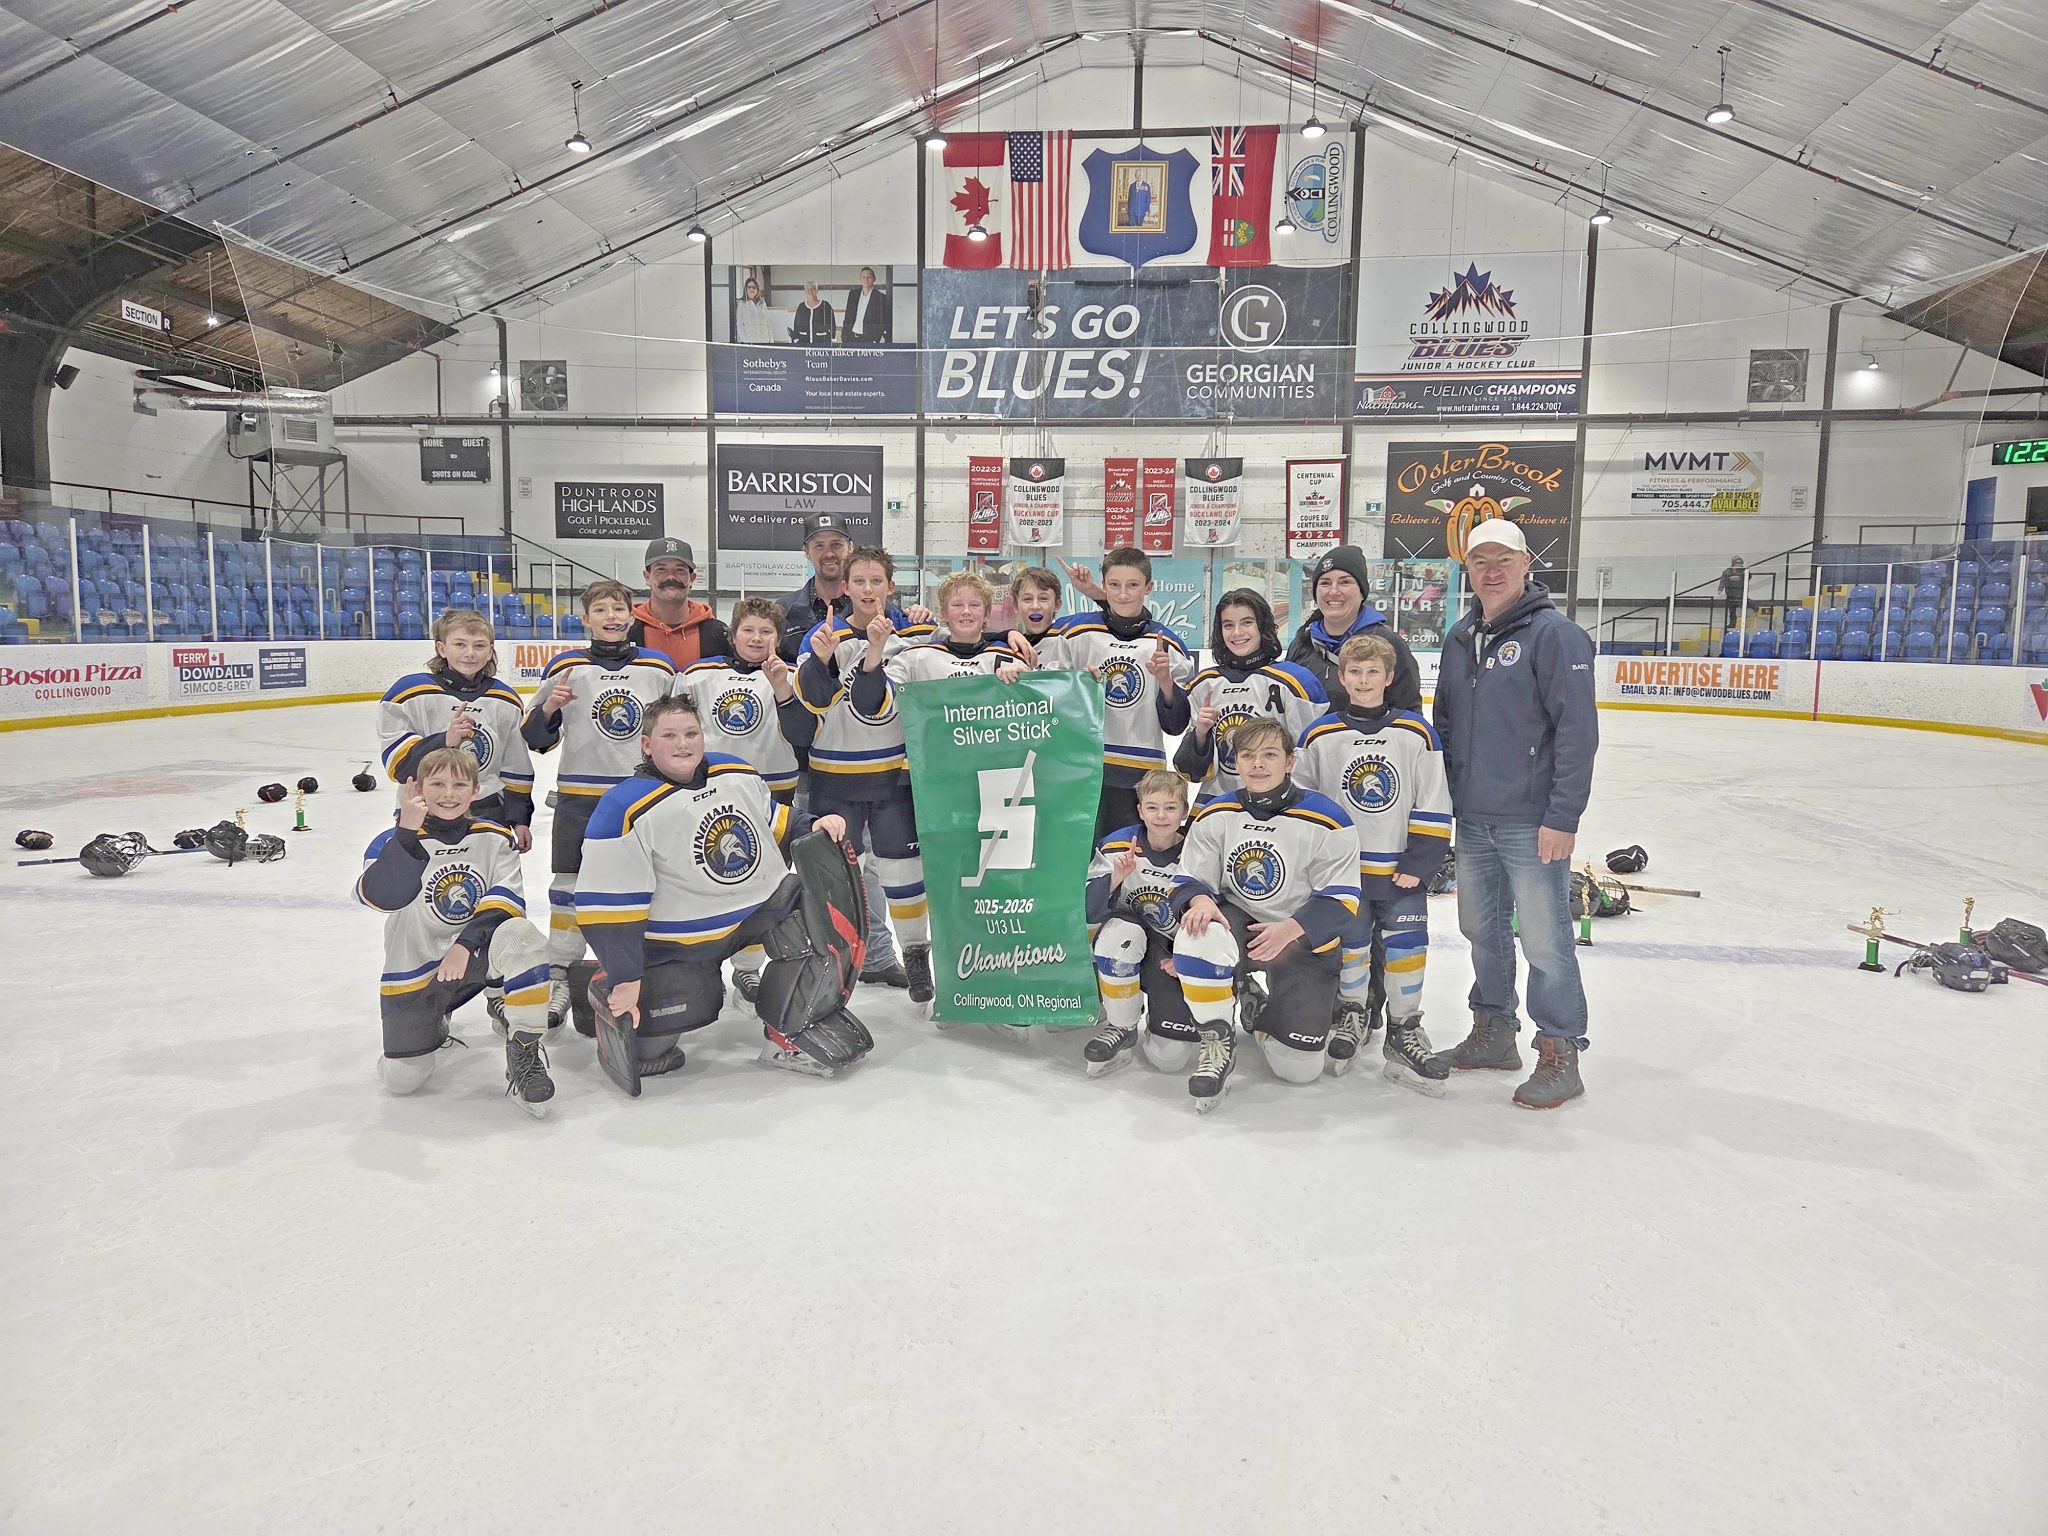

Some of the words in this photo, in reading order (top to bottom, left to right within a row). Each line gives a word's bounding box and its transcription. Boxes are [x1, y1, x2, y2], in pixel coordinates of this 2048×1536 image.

[1327, 147, 1341, 237] COLLINGWOOD
[125, 306, 158, 326] SECTION
[164, 318, 171, 330] R
[949, 305, 1060, 341] LET'S
[1071, 304, 1141, 341] GO
[1230, 294, 1270, 342] G
[1410, 321, 1529, 335] COLLINGWOOD
[805, 349, 830, 357] Rioux
[857, 349, 885, 357] Davies
[1408, 334, 1531, 360] BLUES
[743, 358, 787, 369] Sotheby's
[804, 360, 828, 369] Team
[1401, 362, 1441, 370] JUNIOR
[1446, 361, 1452, 369] A
[1457, 361, 1502, 369] HOCKEY
[1507, 360, 1536, 368] CLUB
[937, 349, 1150, 400] BLUES!
[1186, 363, 1315, 384] GEORGIAN
[749, 383, 782, 392] Canada
[805, 390, 818, 398] Your
[863, 391, 886, 399] experts.
[1186, 385, 1315, 399] COMMUNITIES
[1423, 385, 1484, 397] FUELING
[1486, 383, 1577, 396] CHAMPIONS
[1356, 400, 1419, 415] Nutrafarms
[1436, 402, 1500, 412] www.nutrafarms.ca
[1511, 402, 1562, 411] 1.844.224.7007
[423, 439, 444, 447] HOME
[462, 439, 485, 447] GUEST
[1397, 449, 1476, 493] Osler
[1475, 443, 1563, 492] Brook
[1645, 452, 1730, 471] MVMT
[728, 469, 872, 495] BARRISTON
[1013, 485, 1060, 493] COLLINGWOOD
[1189, 485, 1238, 493] COLLINGWOOD
[1430, 478, 1452, 495] Golf
[1453, 473, 1471, 484] and
[1472, 470, 1508, 483] Country
[1510, 477, 1531, 493] Club
[561, 486, 657, 498] DUNTROON
[562, 499, 657, 513] HIGHLANDS
[784, 498, 817, 509] LAW
[1711, 499, 1759, 509] AVAILABLE
[567, 516, 592, 525] GOLF
[600, 516, 652, 526] PICKLEBALL
[729, 515, 746, 523] We
[750, 514, 787, 524] deliver
[1390, 513, 1429, 525] Believe
[1511, 513, 1557, 525] Achieve
[1151, 580, 1196, 592] Home
[1109, 642, 1139, 650] CCM
[176, 651, 208, 664] TERRY
[0, 665, 80, 687] Boston
[85, 662, 142, 682] Pizza
[182, 665, 248, 681] DOWDALL
[521, 669, 542, 678] EMAIL
[1615, 660, 1723, 687] ADVERTISE
[1728, 663, 1780, 690] HERE
[35, 685, 112, 700] COLLINGWOOD
[183, 680, 252, 695] SIMCOE-GREY
[1621, 684, 1645, 694] EMAIL
[1647, 685, 1658, 695] US
[1659, 686, 1672, 696] AT:
[1673, 687, 1771, 701] INFO@CWOODBLUES.COM
[591, 688, 632, 720] WINGHAM
[711, 687, 754, 716] WINGHAM
[1265, 683, 1285, 714] A
[943, 696, 1054, 723] International
[953, 725, 1002, 746] Silver
[1341, 754, 1387, 791] WINGHAM
[692, 787, 717, 803] CCM
[693, 804, 734, 866] WINGHAM
[1243, 824, 1277, 833] CCM
[434, 847, 470, 856] CCM
[1226, 840, 1275, 874] WINGHAM
[722, 863, 749, 878] MINOR
[1142, 868, 1174, 879] CCM
[424, 863, 471, 904] WINGHAM
[974, 898, 1035, 915] 2025-2026
[985, 919, 1008, 935] U13
[1010, 918, 1027, 934] LL
[957, 942, 1067, 980] Champions
[953, 993, 1015, 1010] Collingwood,
[1017, 994, 1036, 1008] ON
[1037, 994, 1082, 1011] Regional
[1161, 1020, 1196, 1033] CCM
[1288, 1032, 1324, 1044] CCM
